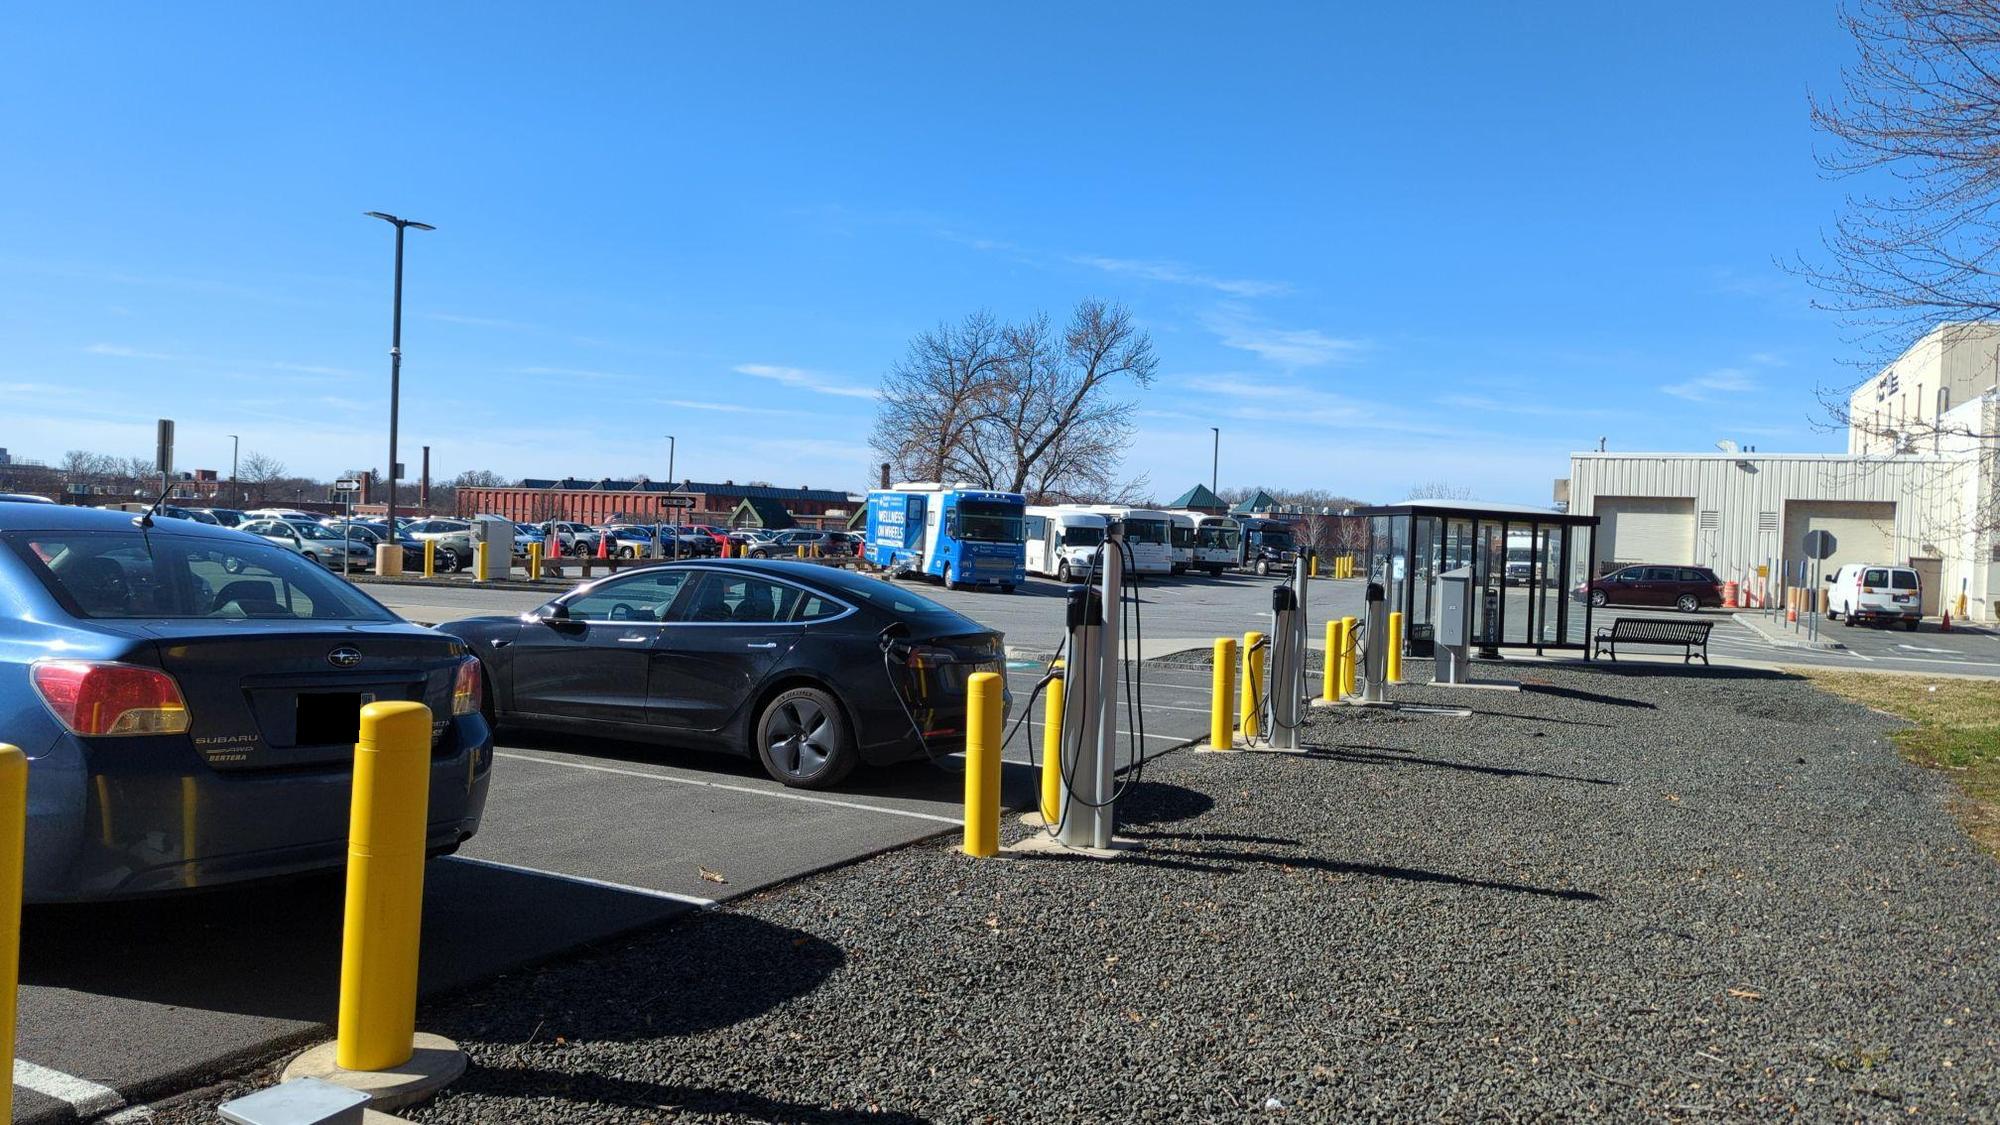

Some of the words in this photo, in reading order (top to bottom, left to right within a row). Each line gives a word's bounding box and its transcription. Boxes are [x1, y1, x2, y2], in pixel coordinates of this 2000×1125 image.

[878, 510, 904, 523] WELLNESS
[885, 526, 903, 538] WHEELS
[195, 735, 258, 744] SUBARU
